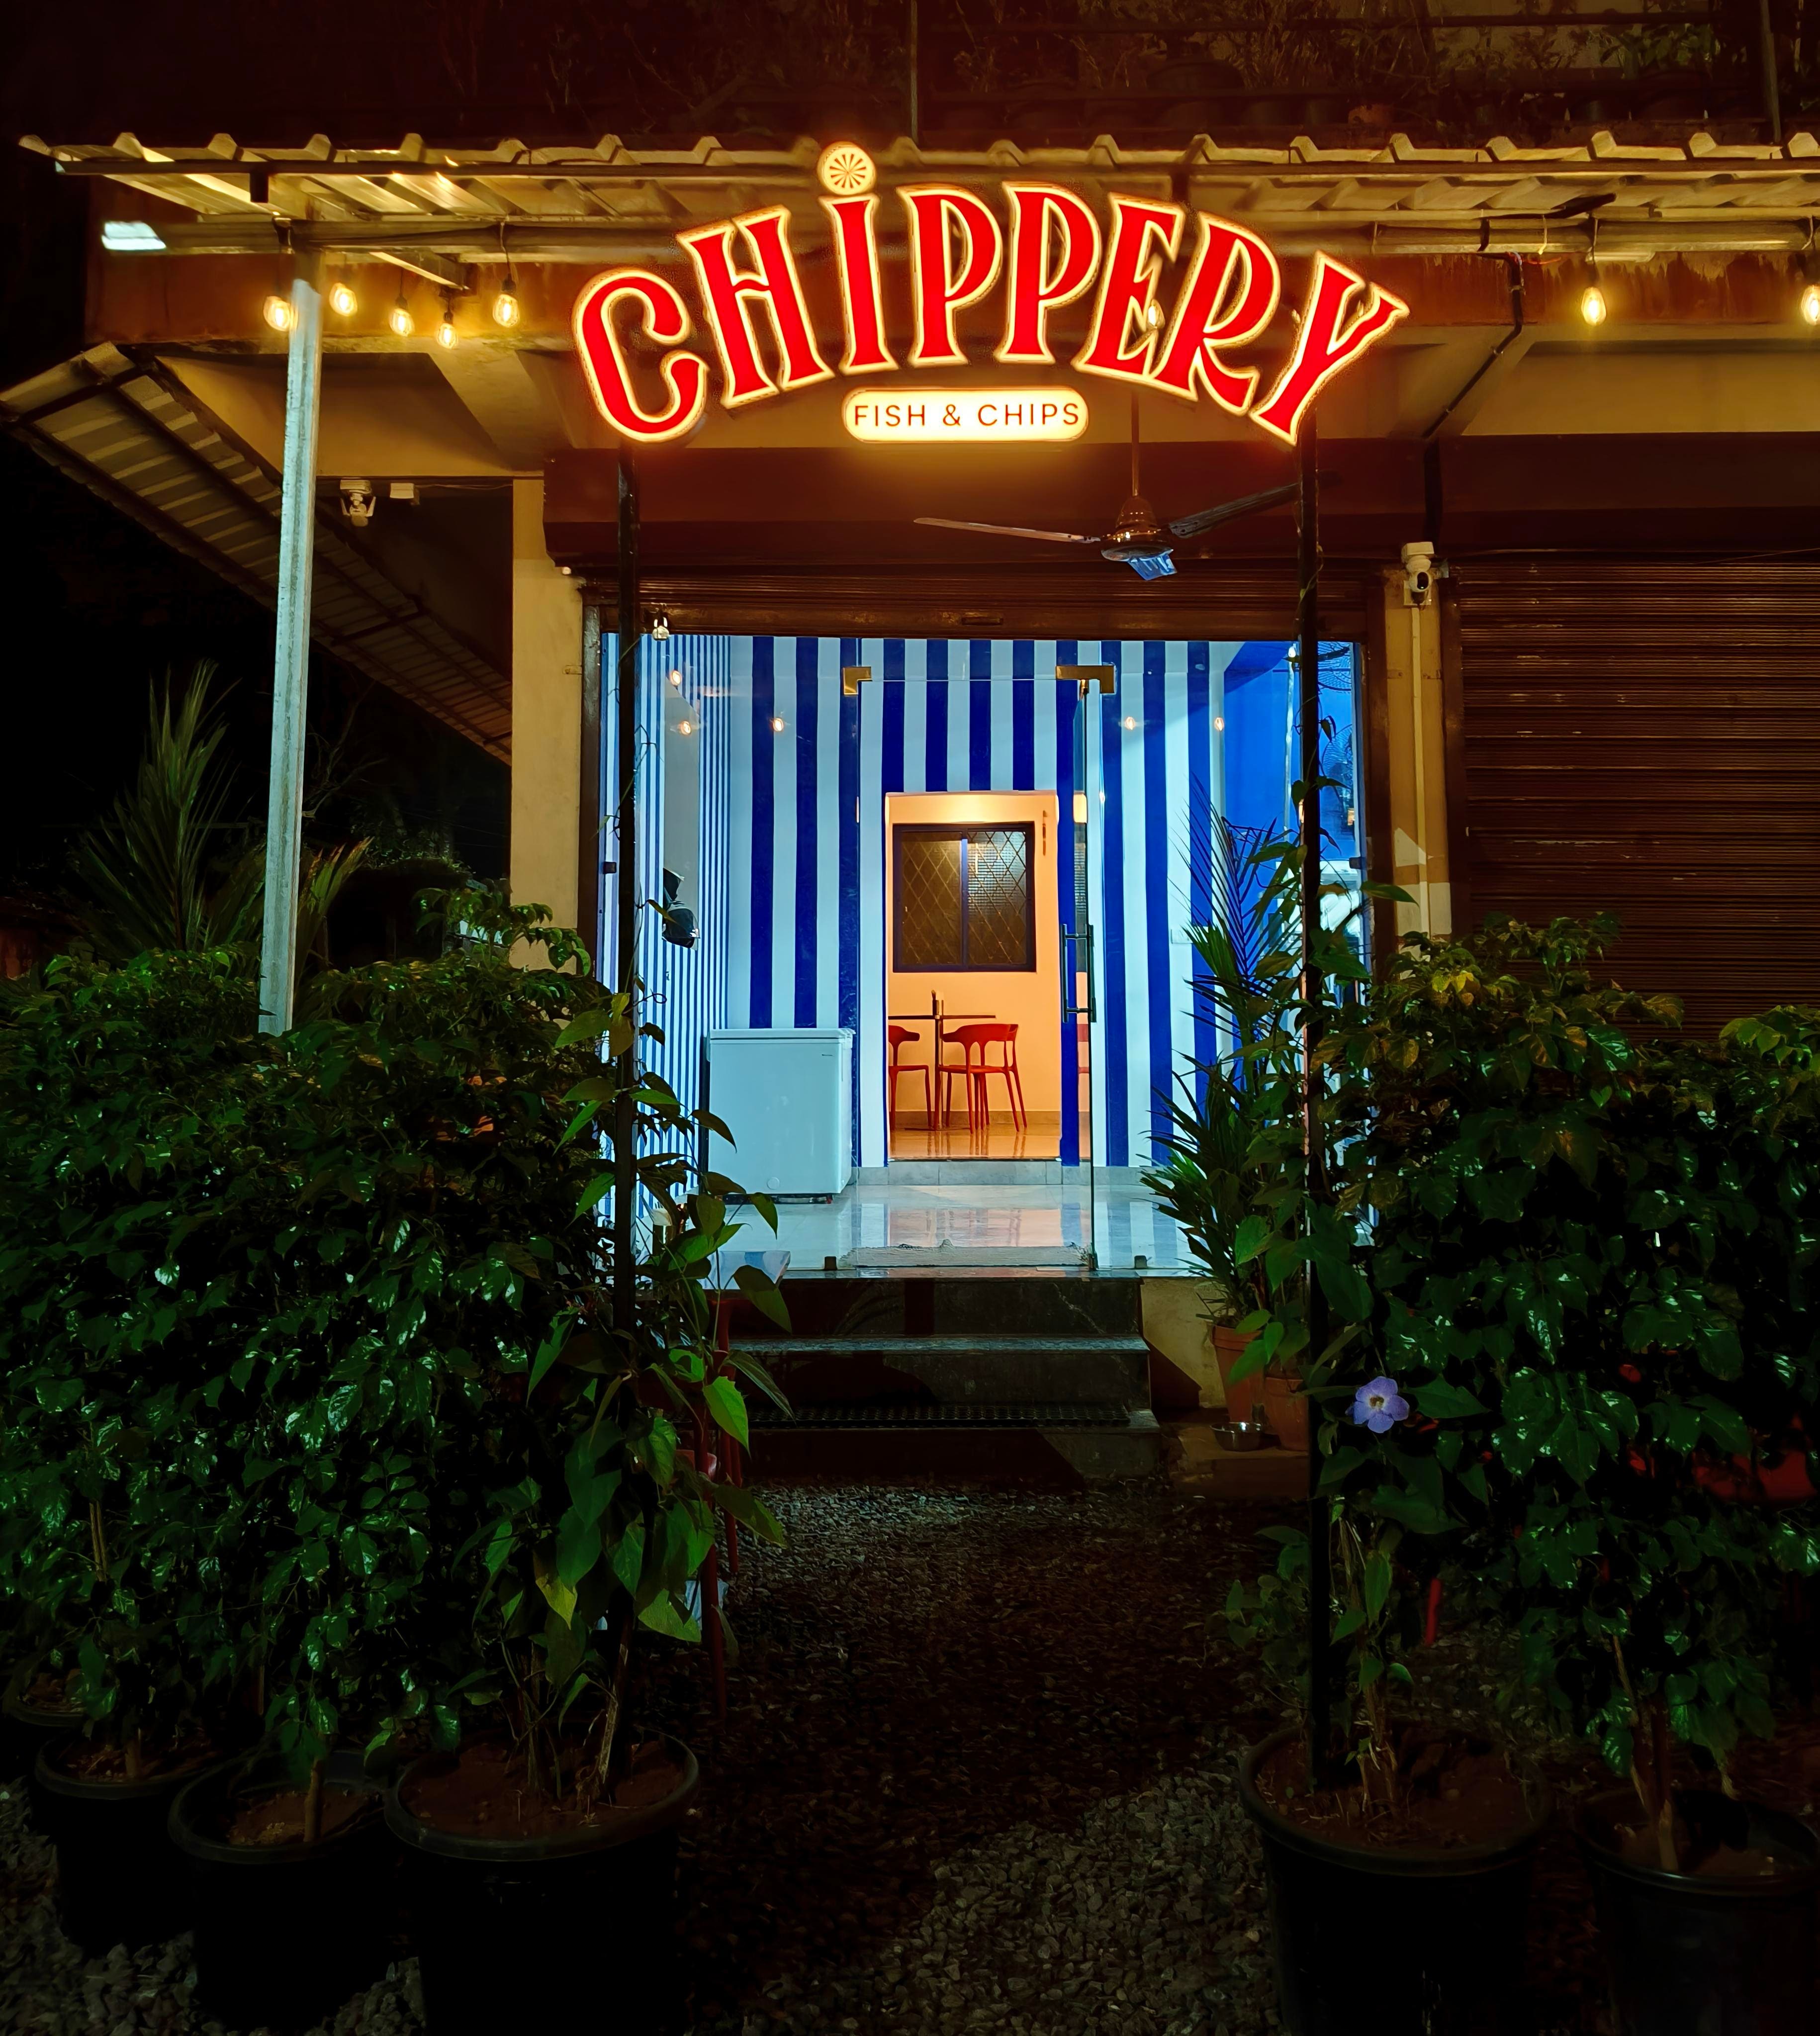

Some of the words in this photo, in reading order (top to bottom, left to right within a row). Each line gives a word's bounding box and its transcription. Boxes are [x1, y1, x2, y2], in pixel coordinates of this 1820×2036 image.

[854, 405, 925, 427] FISH
[942, 404, 961, 426] &
[978, 403, 1079, 426] CHIPS
